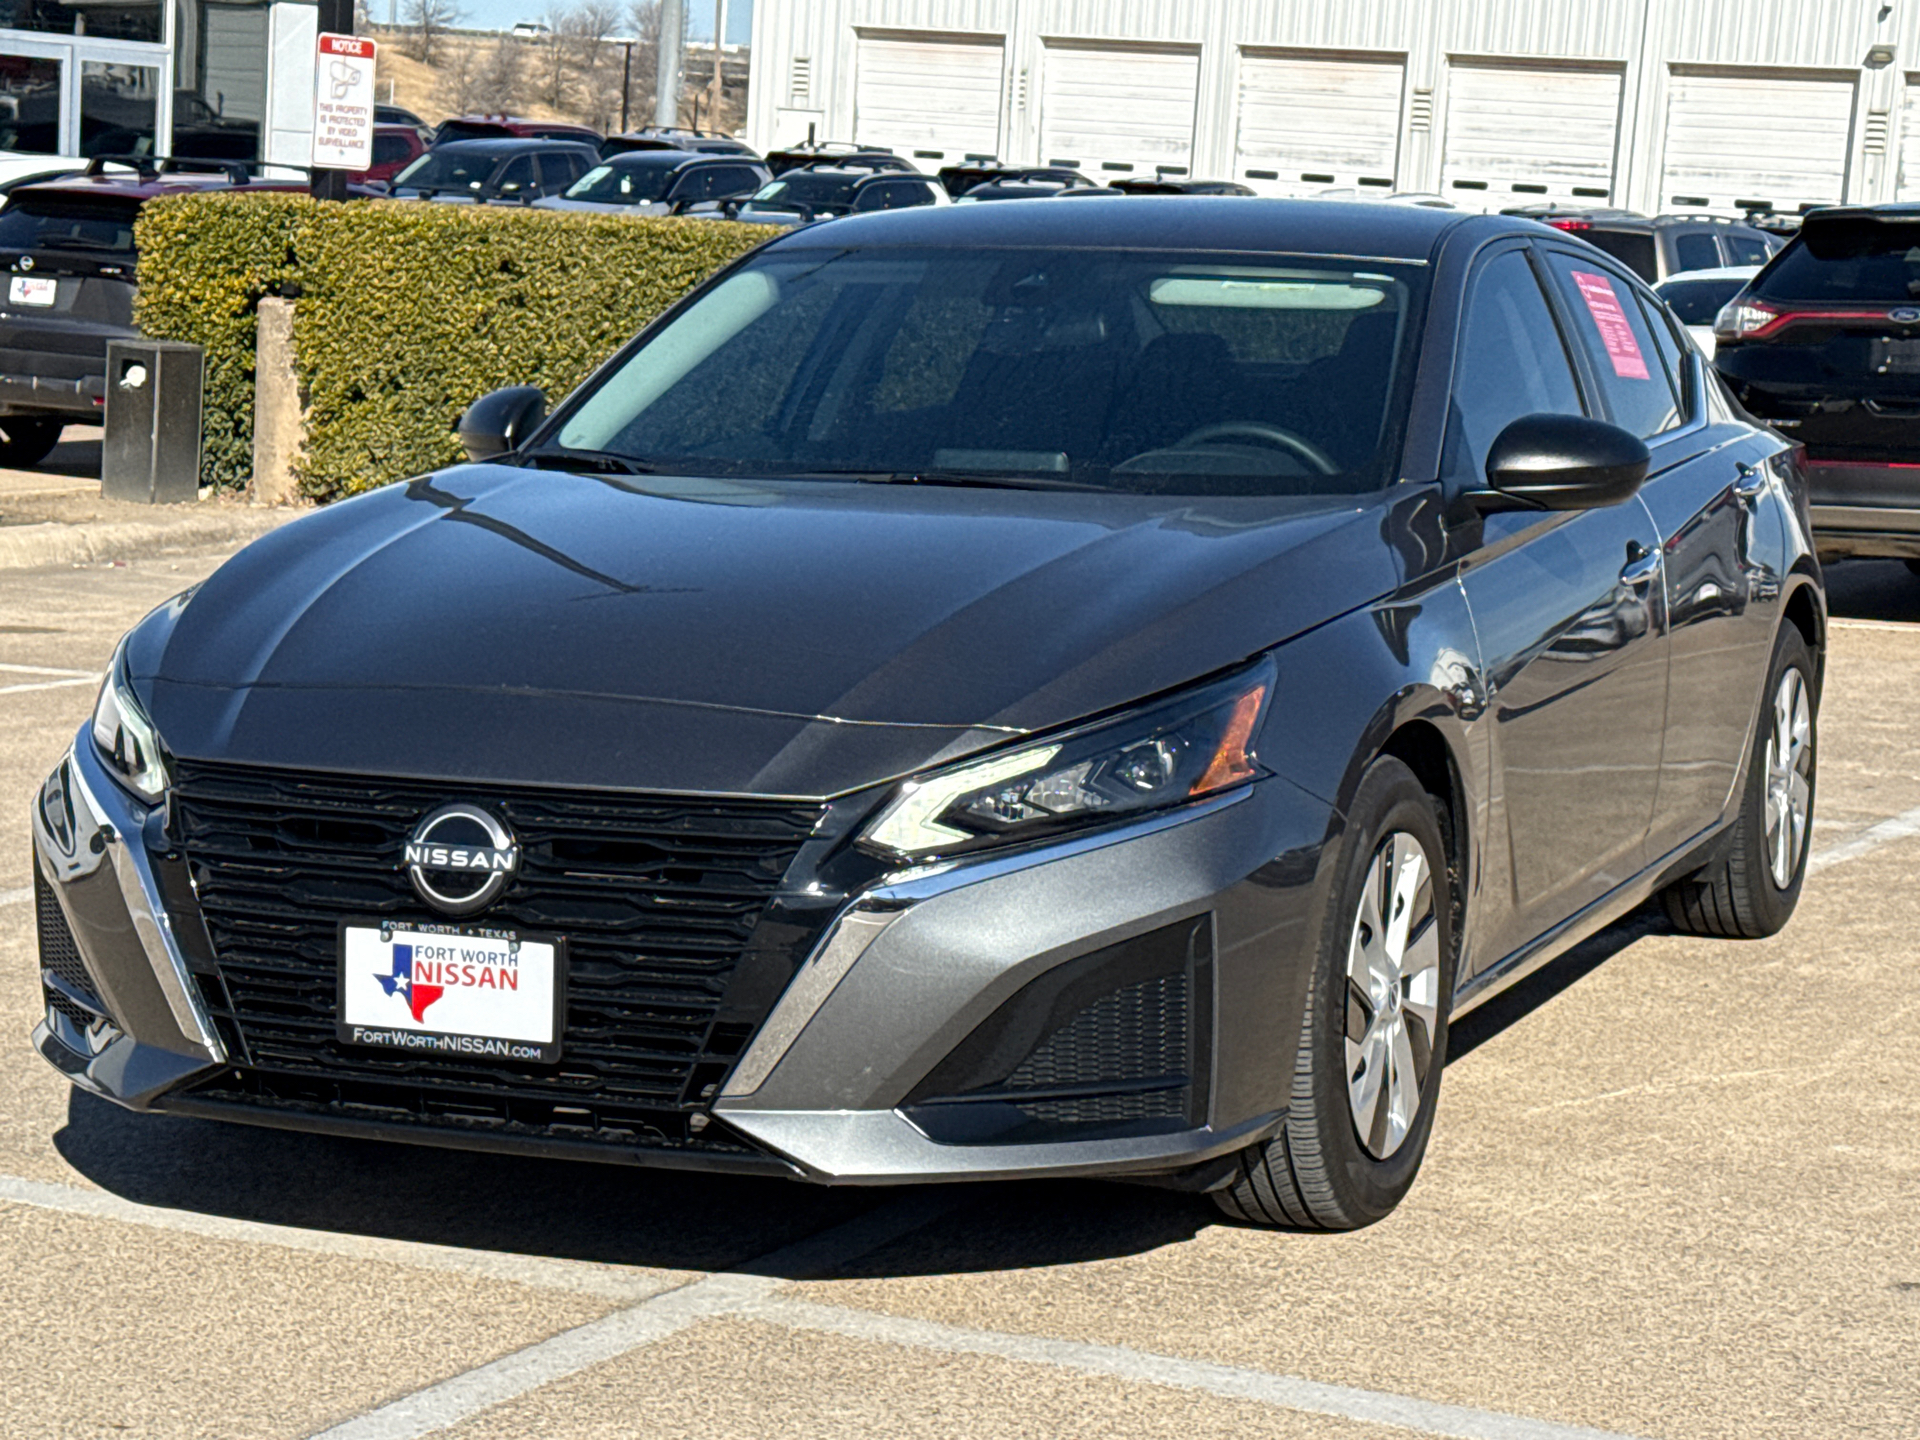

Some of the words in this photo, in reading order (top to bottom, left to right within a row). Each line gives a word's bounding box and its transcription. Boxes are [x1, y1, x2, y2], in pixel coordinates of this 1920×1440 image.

[331, 39, 363, 54] NOTICE
[319, 102, 333, 113] THIS
[335, 104, 368, 115] PROPERTY
[320, 114, 327, 123] IS
[329, 115, 366, 127] PROTECTED
[327, 126, 336, 135] BY
[338, 127, 358, 137] VIDEO
[318, 136, 365, 149] SURVEILLANCE
[404, 845, 513, 870] NISSAN
[382, 920, 412, 931] FORT
[418, 923, 460, 935] WORTH
[478, 928, 517, 940] TEXAS
[415, 945, 456, 962] FORT
[461, 948, 519, 967] WORTH
[414, 961, 518, 991] NISSAN
